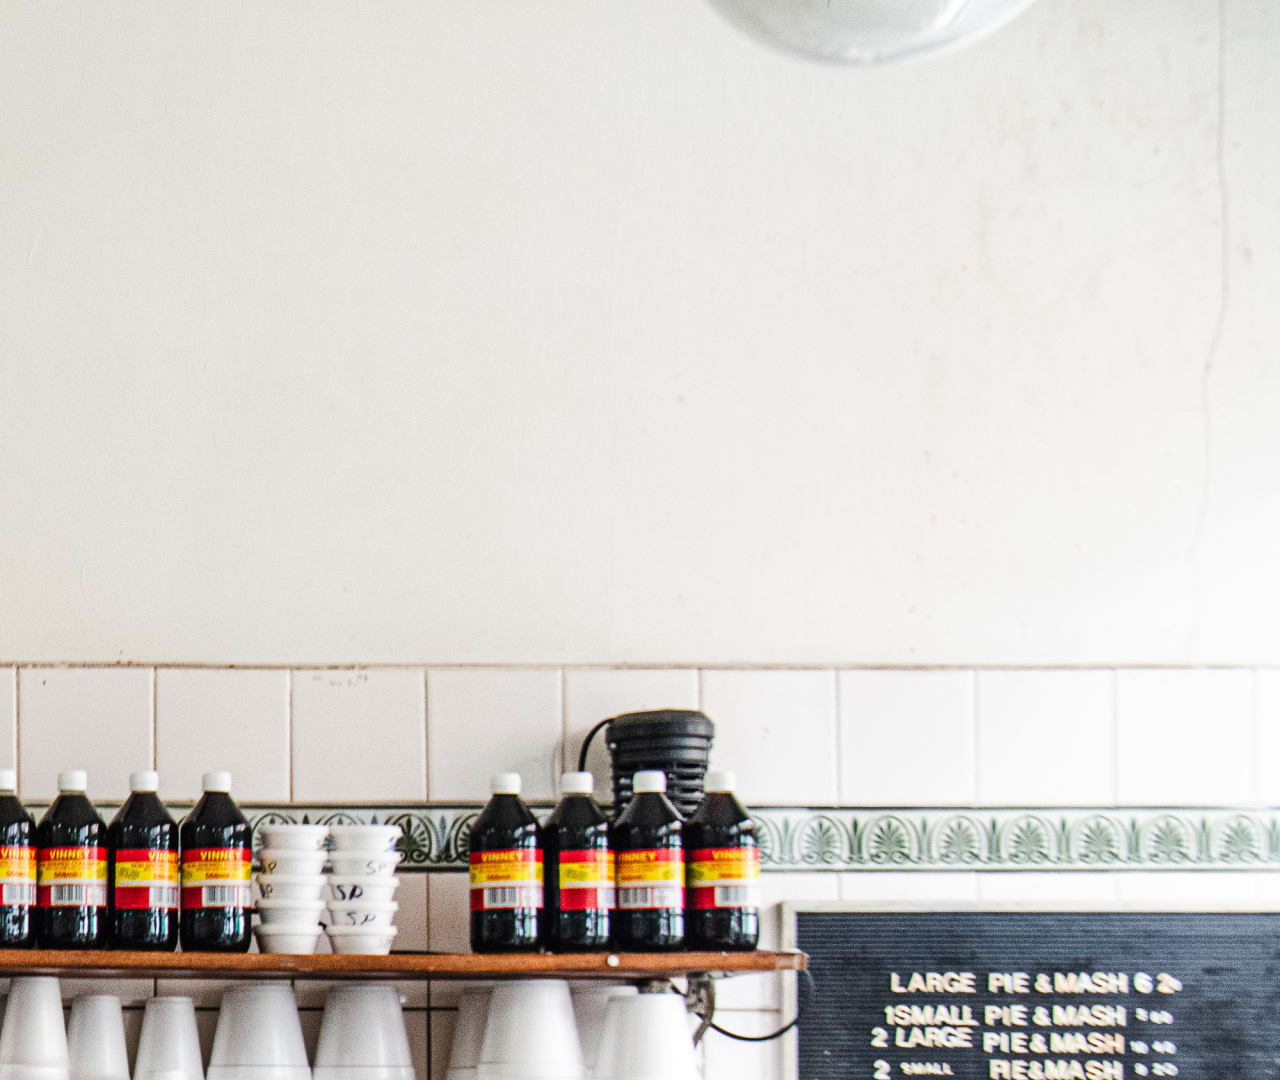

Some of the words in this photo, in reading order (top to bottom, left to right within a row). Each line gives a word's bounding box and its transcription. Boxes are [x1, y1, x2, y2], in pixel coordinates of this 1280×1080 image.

[890, 971, 977, 993] LARGE
[988, 971, 1031, 994] PIE
[984, 1005, 1029, 1026] PIE
[870, 1026, 889, 1048] 2
[895, 1026, 974, 1048] LARGE
[872, 1059, 891, 1080] 2
[899, 1061, 955, 1076] SMALL
